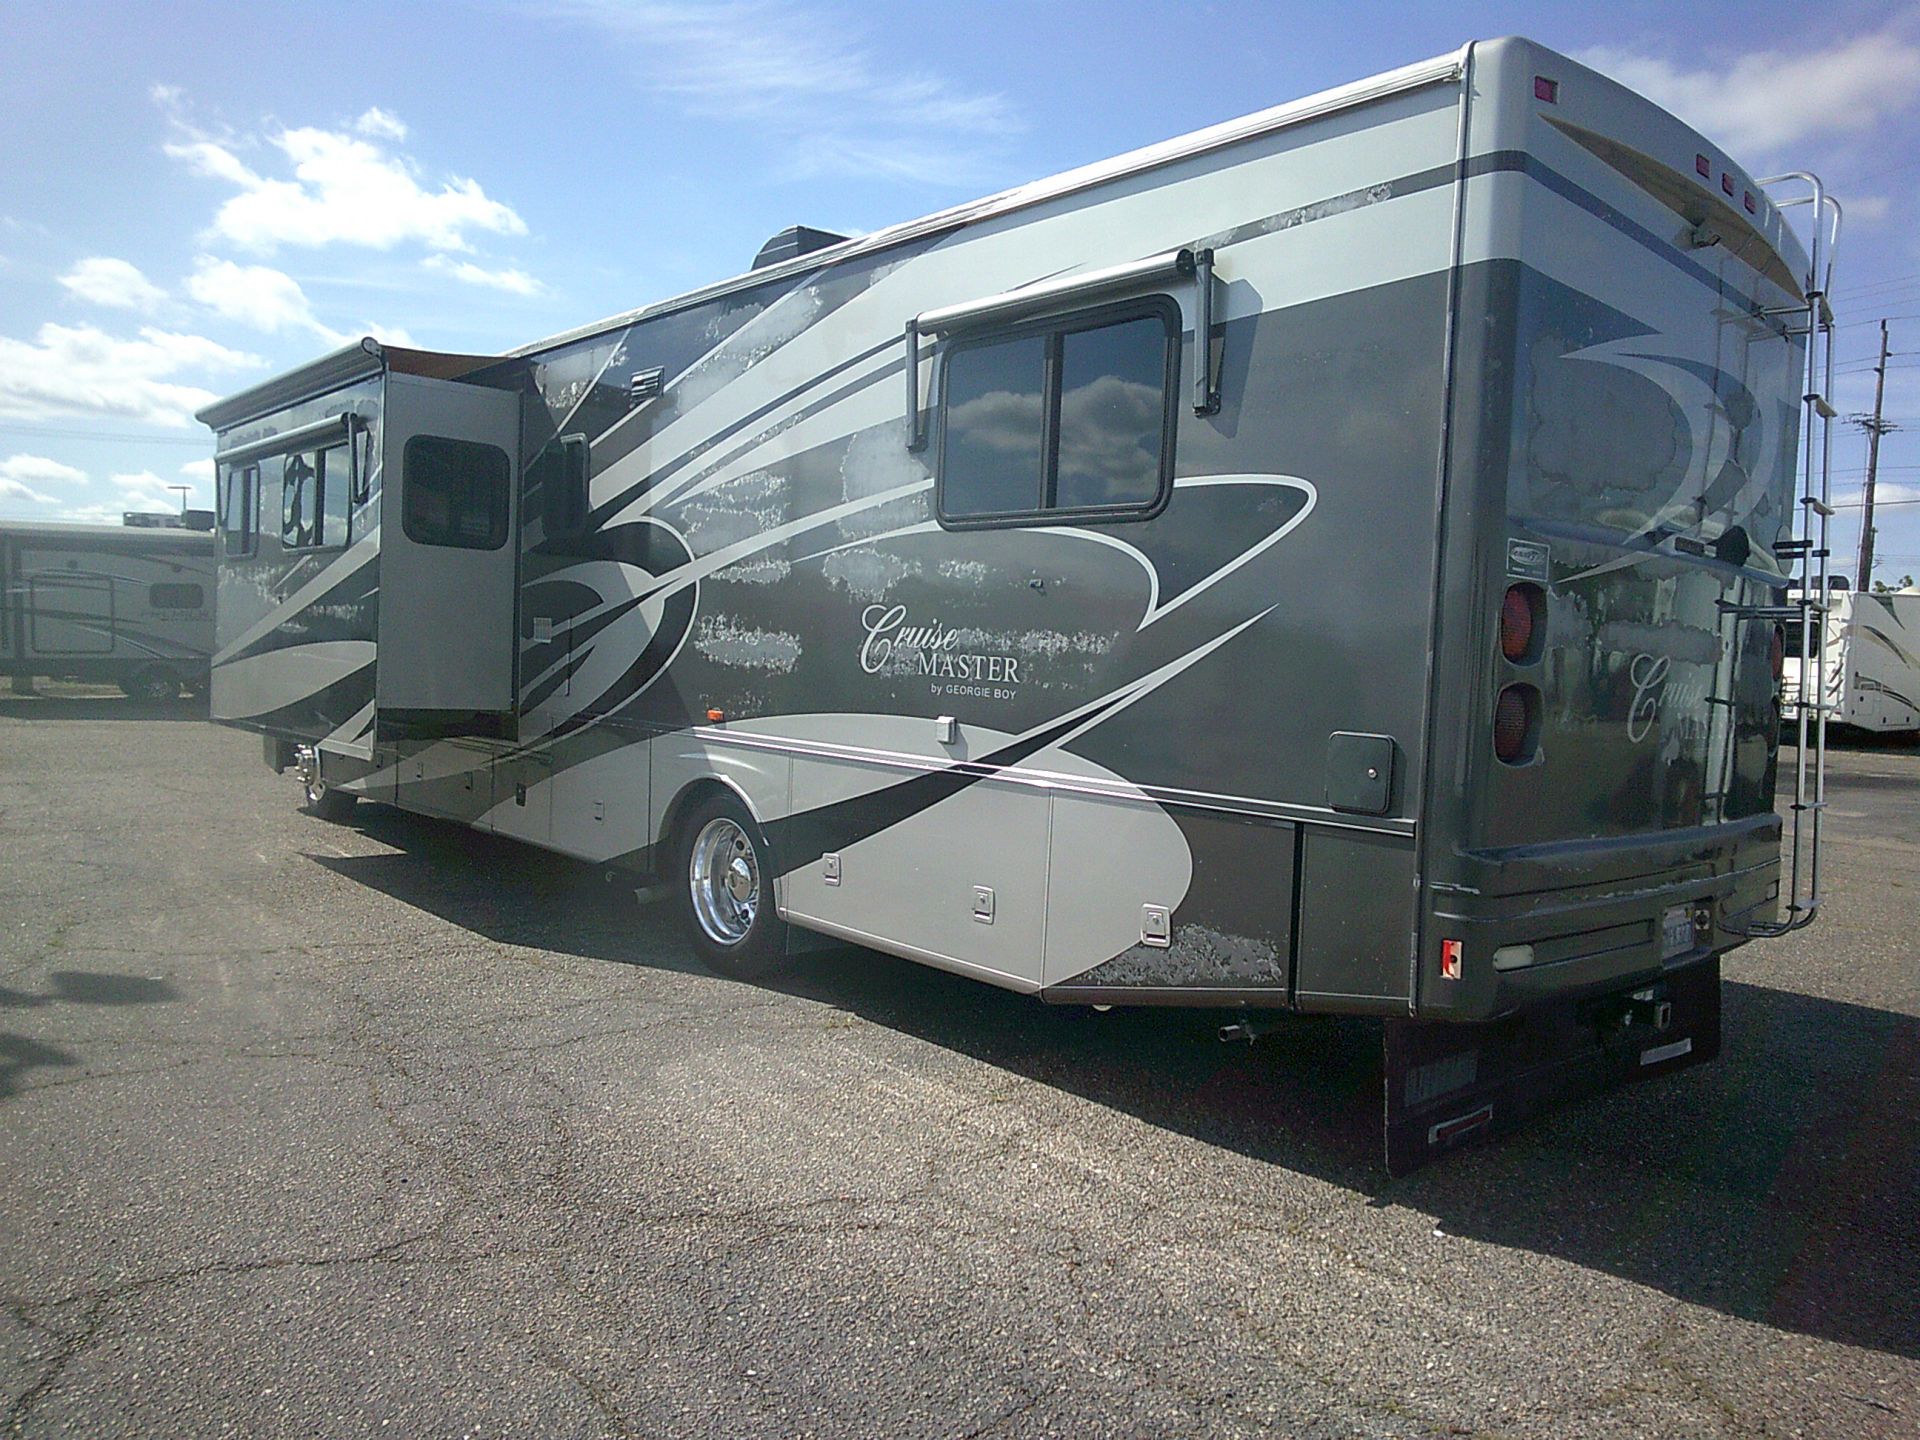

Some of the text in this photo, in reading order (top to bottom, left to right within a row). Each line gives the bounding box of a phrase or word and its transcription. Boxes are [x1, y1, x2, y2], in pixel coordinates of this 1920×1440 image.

[861, 604, 959, 674] Cruise
[917, 652, 1020, 683] MASTER
[930, 684, 1017, 699] by GEORGIE BOY
